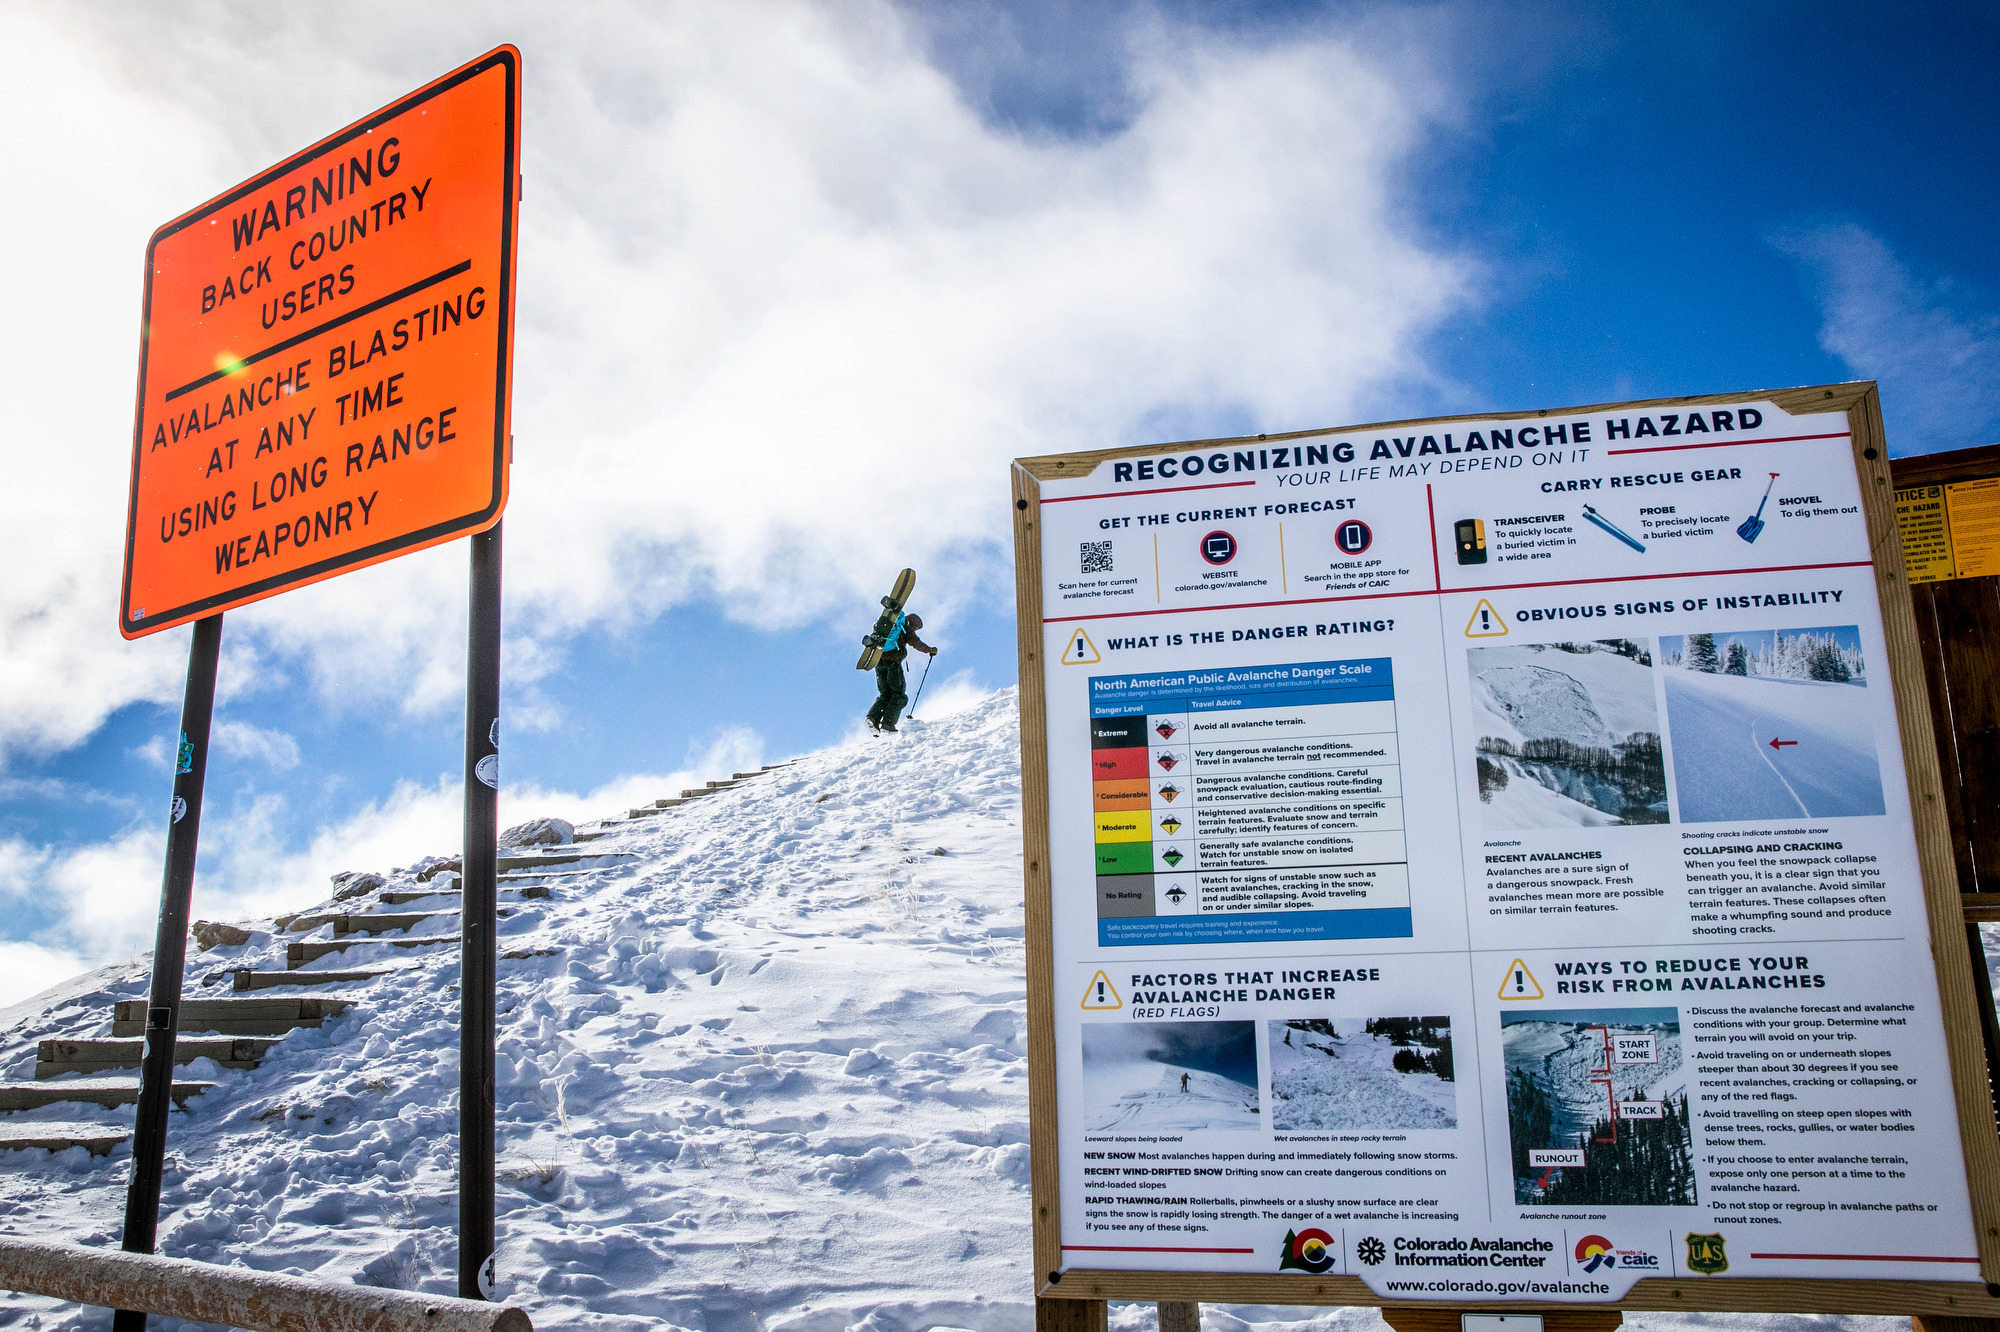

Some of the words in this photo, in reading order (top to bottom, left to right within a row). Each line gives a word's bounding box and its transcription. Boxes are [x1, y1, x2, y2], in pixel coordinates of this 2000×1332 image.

[232, 137, 400, 252] WARNING
[201, 255, 272, 315] BACK
[290, 177, 432, 270] COUNTRY
[262, 264, 355, 330] USERS
[151, 359, 311, 453] AVALANCHE
[328, 286, 485, 379] BLASTING
[206, 439, 239, 479] AT
[255, 407, 316, 459] ANY
[335, 372, 404, 426] TIME
[1114, 442, 1355, 483] RECOGNIZING
[1369, 421, 1592, 461] AVALANCHE
[1606, 408, 1763, 441] HAZARD
[161, 490, 236, 543] USING
[252, 456, 327, 511] LONG
[346, 406, 457, 477] RANGE
[1276, 471, 1331, 488] YOUR
[1339, 466, 1380, 482] LIFE
[1389, 462, 1432, 478] MAY
[1440, 455, 1523, 474] DEPEND
[1532, 451, 1562, 466] ON
[1572, 449, 1590, 463] IT
[1541, 478, 1603, 493] CARRY
[1610, 472, 1684, 488] RESCUE
[1690, 468, 1742, 482] GEAR
[1779, 496, 1822, 506] SHOVEL
[1913, 503, 1940, 512] HAZARD
[1099, 517, 1131, 530] GET
[1137, 513, 1170, 526] THE
[1176, 506, 1257, 523] CURRENT
[1264, 498, 1356, 516] FORECAST
[1639, 506, 1676, 516] PROBE
[1780, 510, 1793, 518] To
[1795, 508, 1811, 518] dig
[1812, 508, 1839, 516] them
[1841, 506, 1858, 514] out
[1493, 514, 1565, 526] TRANSCEIVER
[1641, 519, 1653, 527] To
[1655, 516, 1698, 528] precisely
[1700, 515, 1730, 523] locate
[215, 490, 378, 575] WEAPONRY
[1495, 530, 1507, 538] To
[1508, 528, 1542, 539] quickly
[1544, 526, 1573, 535] locate
[1651, 529, 1682, 539] buried
[1684, 527, 1714, 537] victim
[1504, 540, 1535, 550] buried
[1536, 538, 1565, 547] victim
[1567, 537, 1577, 545] in
[1505, 553, 1528, 561] wide
[1530, 552, 1552, 560] area
[1330, 561, 1363, 570] MOBILE
[1364, 559, 1382, 568] APP
[1202, 570, 1238, 579] WEBSITE
[1174, 579, 1268, 592] colorado.gov/avalanche
[1325, 582, 1356, 591] Friends
[1358, 581, 1367, 589] of
[1368, 579, 1390, 588] CAIC
[1516, 605, 1607, 622] OBVIOUS
[1614, 600, 1675, 616] SIGNS
[1682, 598, 1708, 612] OF
[1716, 590, 1843, 610] INSTABILITY
[1107, 636, 1159, 650] WHAT
[1166, 634, 1183, 646] IS
[1189, 631, 1225, 645] THE
[1232, 625, 1308, 642] DANGER
[1315, 619, 1395, 636] RATING?
[1094, 679, 1127, 691] North
[1130, 676, 1185, 689] American
[1188, 672, 1224, 685] Public
[1227, 669, 1289, 682] Avalanche
[1292, 668, 1336, 679] Danger
[1339, 663, 1372, 675] Scale
[1191, 700, 1215, 708] Travel
[1215, 698, 1242, 707] Advice
[1095, 707, 1122, 715] Danger
[1123, 705, 1144, 713] Level
[1193, 722, 1217, 731] Avoid
[1231, 720, 1273, 728] avalanche
[1275, 717, 1306, 726] terrain.
[1099, 761, 1117, 770] High
[1100, 791, 1148, 800] Considerable
[1681, 832, 1715, 840] Shooting
[1742, 829, 1773, 837] indicate
[1773, 828, 1807, 836] unstable
[1683, 845, 1754, 856] COLLAPSING
[1756, 844, 1781, 853] AND
[1783, 841, 1843, 852] CRACKING
[1485, 854, 1527, 864] RECENT
[1529, 851, 1602, 862] AVALANCHES
[1118, 891, 1142, 900] Rating
[1554, 961, 1613, 976] WAYS
[1620, 960, 1647, 974] TO
[1655, 958, 1741, 973] REDUCE
[1748, 956, 1809, 971] YOUR
[1131, 973, 1218, 987] FACTORS
[1224, 971, 1274, 985] THAT
[1282, 968, 1380, 983] INCREASE
[1557, 980, 1605, 994] RISK
[1612, 978, 1673, 992] FROM
[1681, 974, 1826, 991] AVALANCHES
[1132, 989, 1248, 1004] AVALANCHE
[1255, 987, 1336, 1002] DANGER
[1132, 1007, 1165, 1019] (RED
[1170, 1005, 1220, 1018] FLAGS)
[1619, 1040, 1650, 1049] START
[1621, 1050, 1650, 1059] ZONE
[1696, 1051, 1724, 1059] Avoid
[1726, 1050, 1769, 1061] traveling
[1799, 1049, 1857, 1058] underneath
[1859, 1049, 1892, 1059] slopes
[1623, 1106, 1657, 1115] TRACK
[1084, 1152, 1105, 1160] NEW
[1107, 1152, 1136, 1160] SNOW
[1138, 1152, 1159, 1160] Most
[1161, 1152, 1210, 1160] avalanches
[1212, 1152, 1245, 1162] happen
[1247, 1152, 1276, 1162] during
[1278, 1152, 1295, 1160] and
[1297, 1151, 1352, 1162] immediately
[1353, 1151, 1395, 1162] following
[1424, 1152, 1458, 1160] storms.
[1535, 1154, 1579, 1163] RUNOUT
[1519, 1212, 1560, 1220] Avalanche
[1393, 1237, 1468, 1251] Colorado
[1469, 1238, 1554, 1254] Avalanche
[1394, 1252, 1488, 1267] Information
[1489, 1253, 1546, 1267] Center
[1622, 1252, 1658, 1265] caic
[1386, 1279, 1610, 1296] www.colorado.gov/avalanche
